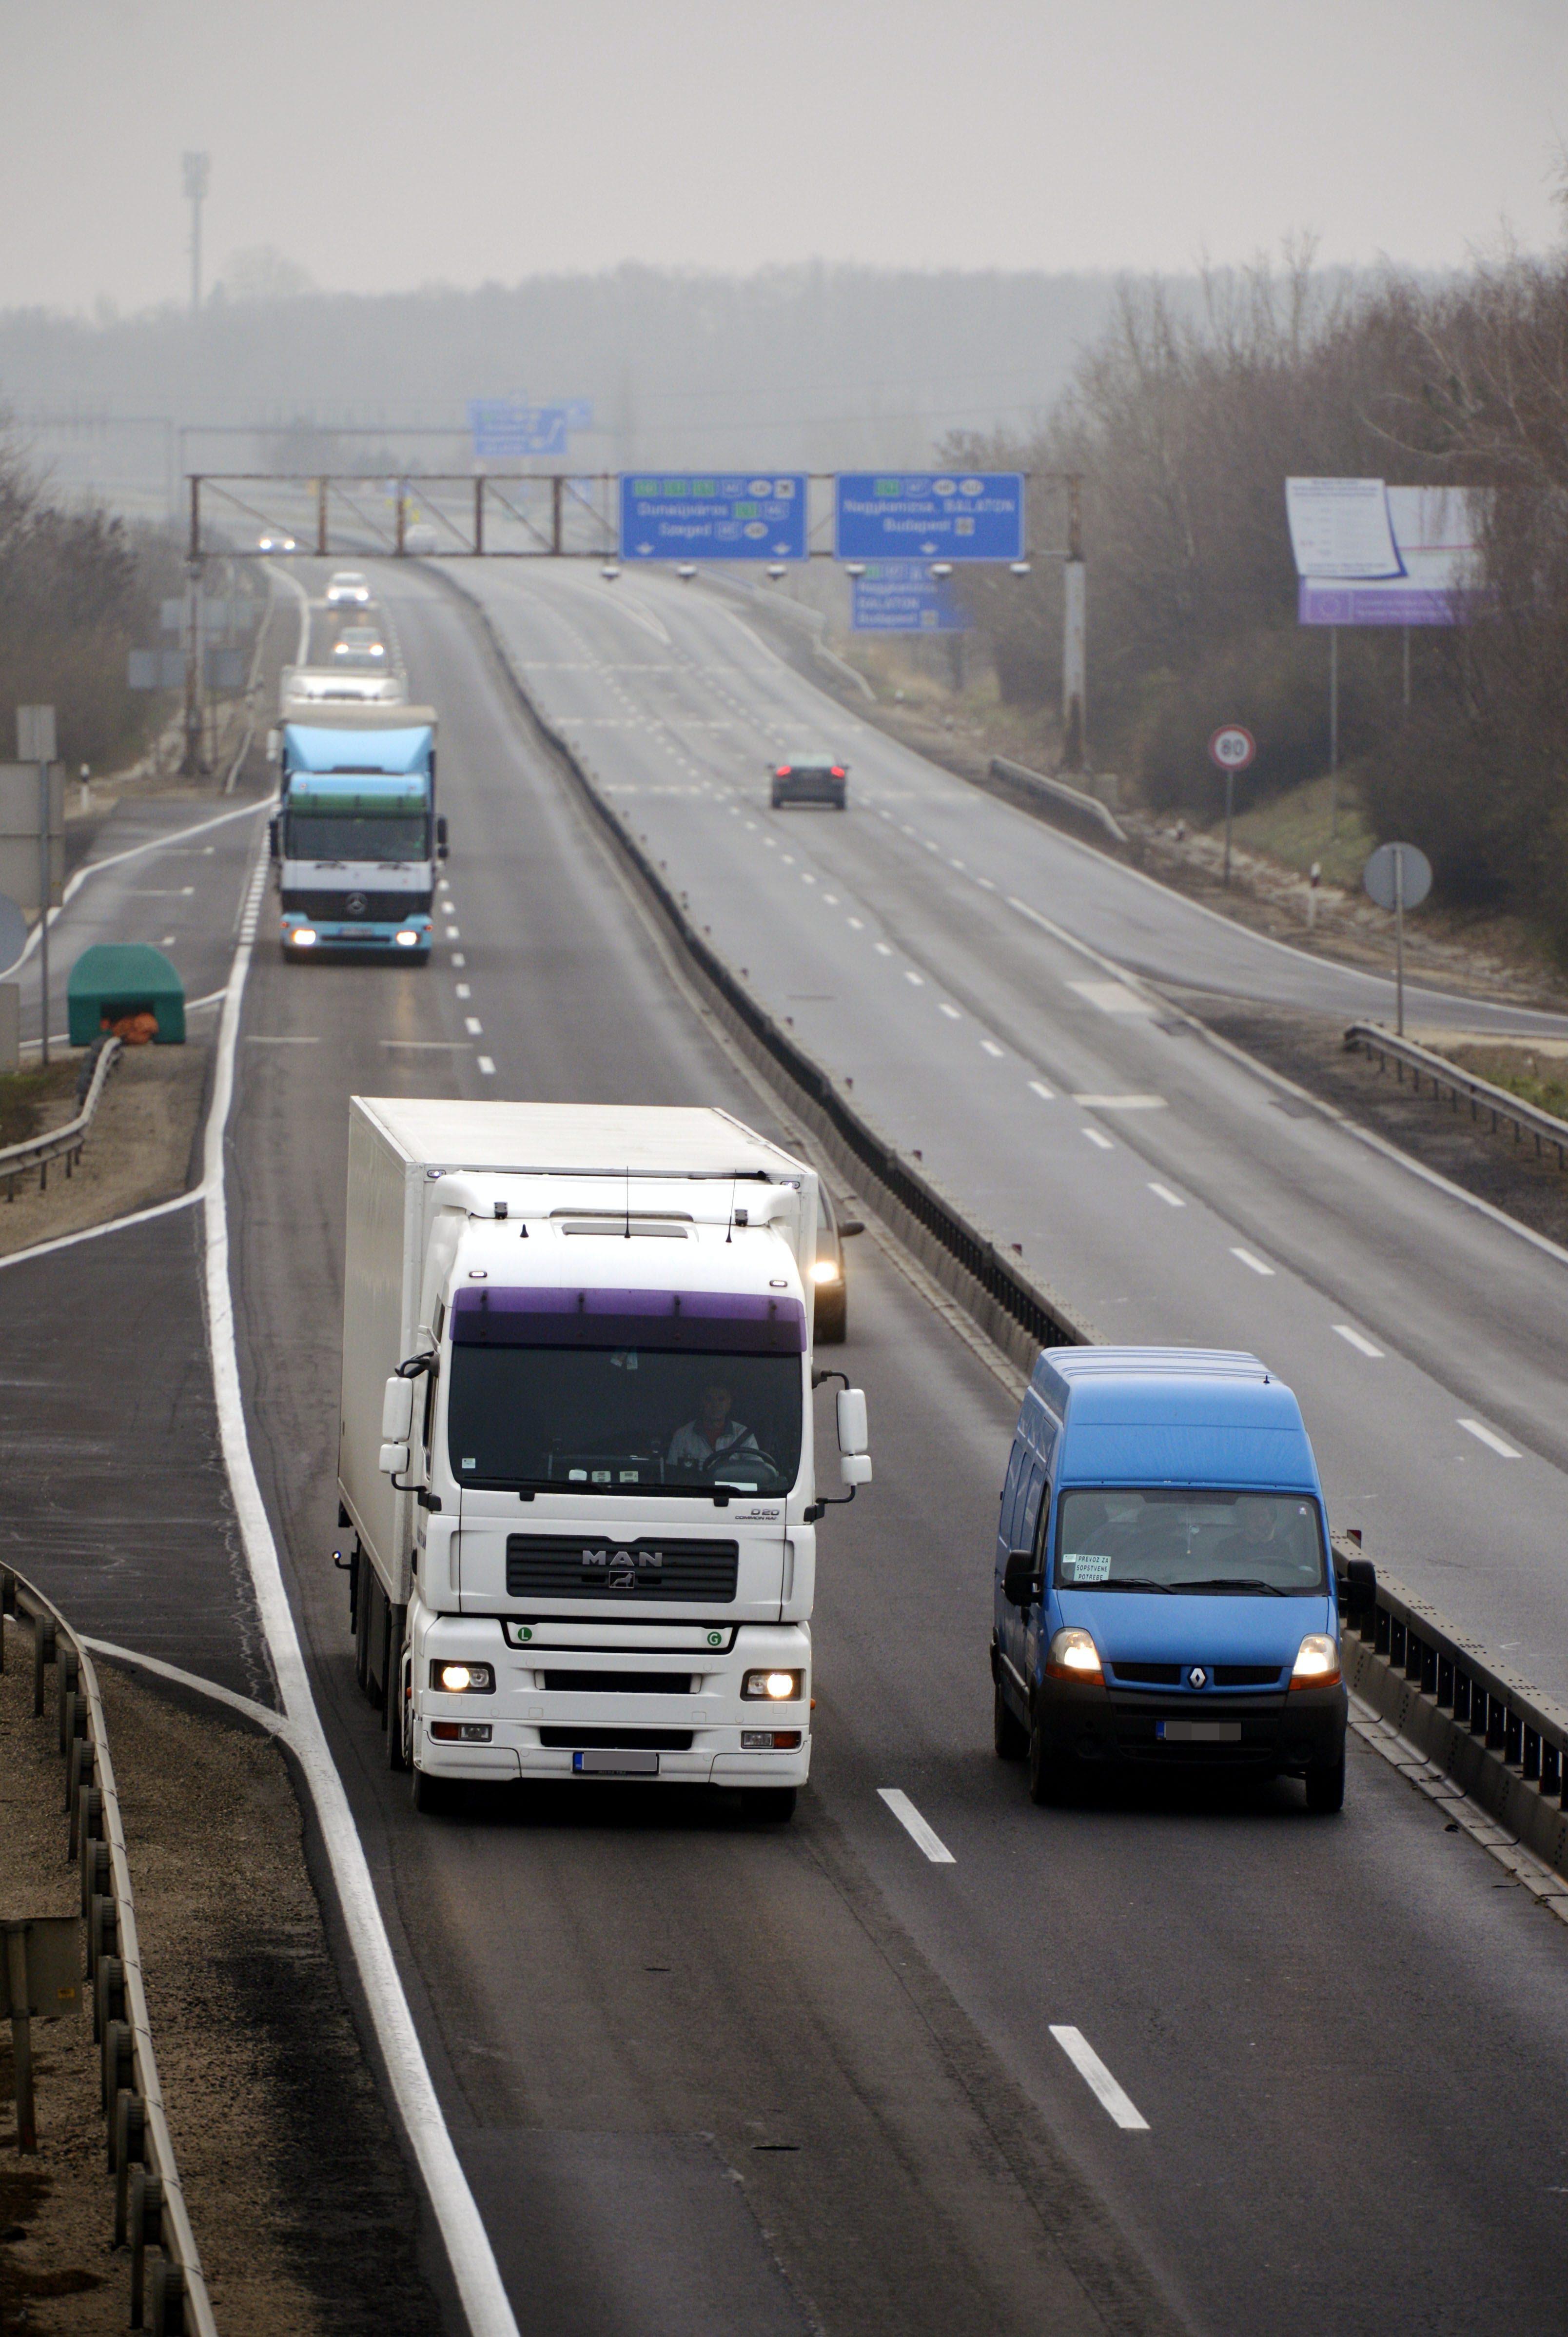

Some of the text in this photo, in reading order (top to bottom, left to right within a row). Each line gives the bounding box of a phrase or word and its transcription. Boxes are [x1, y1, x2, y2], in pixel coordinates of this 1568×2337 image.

[883, 517, 951, 534] Budapest
[583, 1550, 663, 1567] MAN
[522, 1628, 529, 1640] L
[709, 1633, 718, 1644] G
